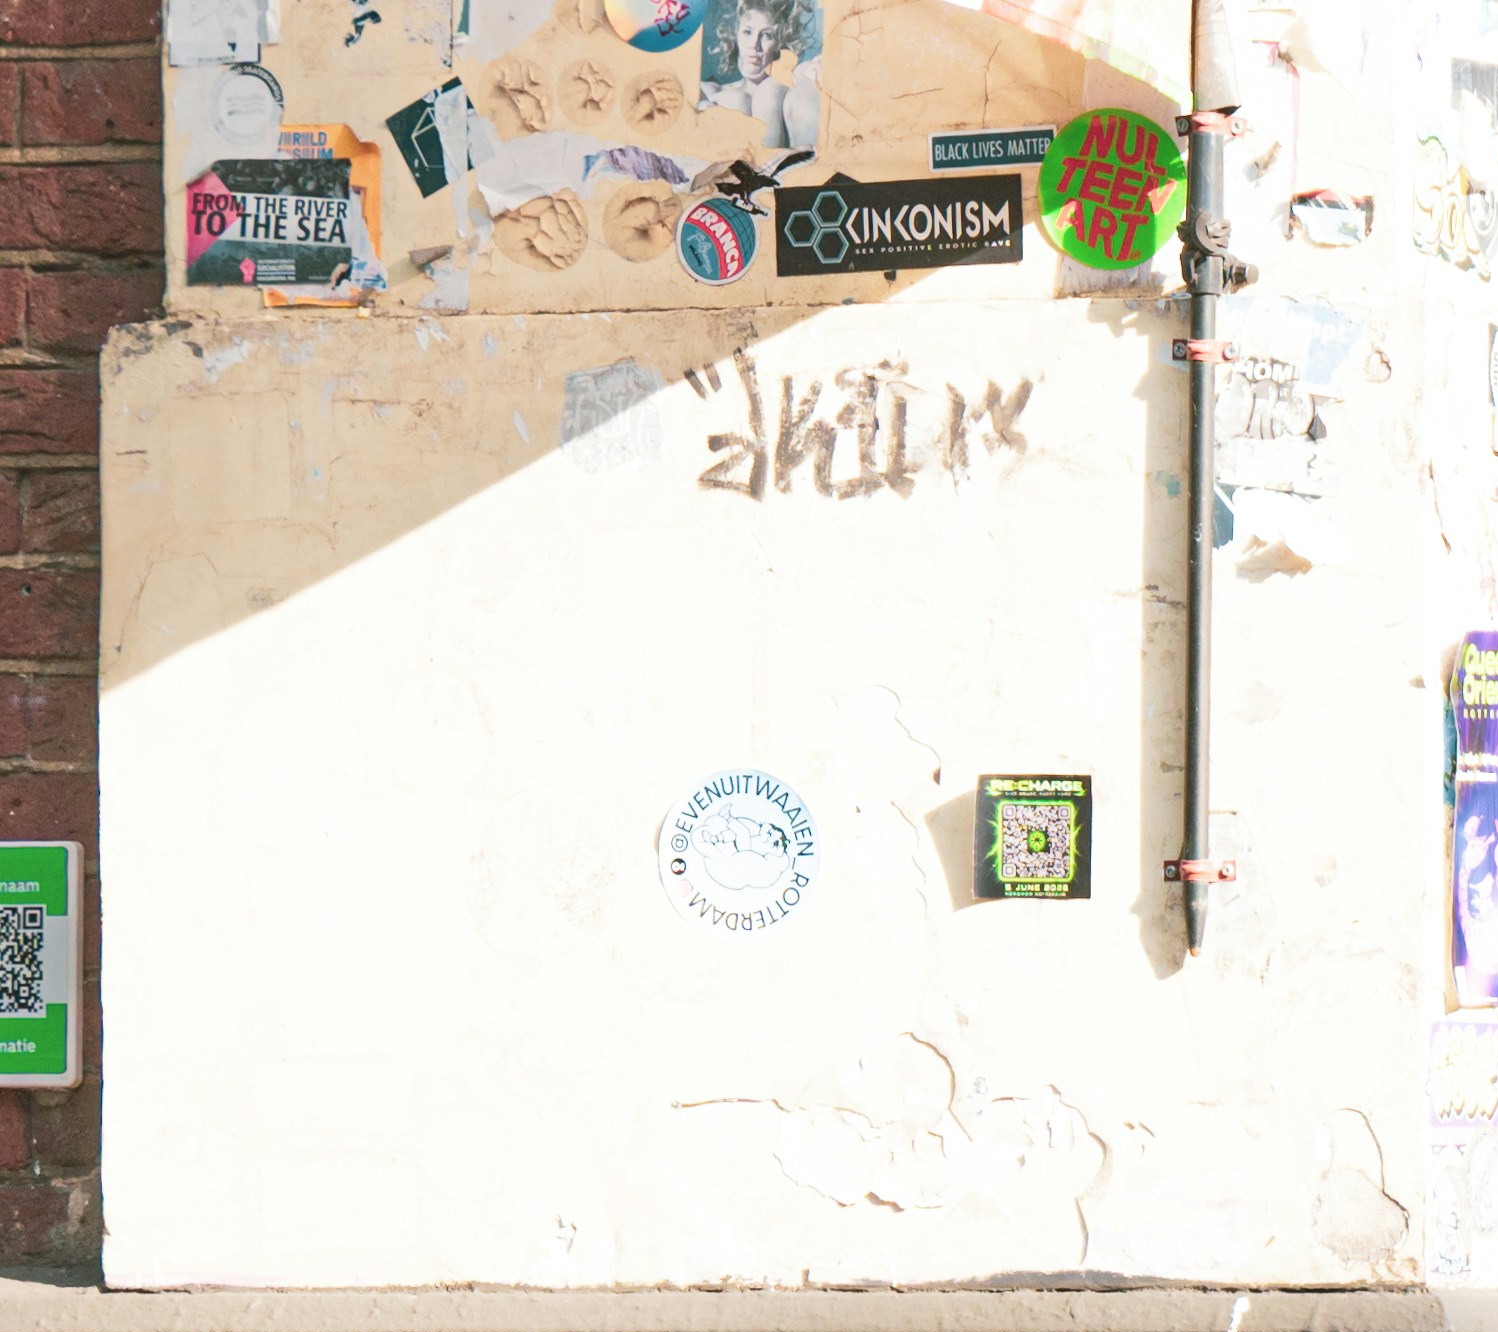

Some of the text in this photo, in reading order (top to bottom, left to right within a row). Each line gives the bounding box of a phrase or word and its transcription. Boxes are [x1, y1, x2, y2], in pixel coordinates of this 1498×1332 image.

[934, 138, 1052, 162] BLACK LIVES MATTER
[1083, 115, 1164, 173] NUL
[1057, 157, 1177, 217] TEEN
[192, 192, 348, 219] FROM THE RIVER
[846, 200, 1011, 244] KINKONISM
[192, 209, 347, 244] TO THE SEA
[690, 205, 742, 280] BRANCA
[855, 239, 1011, 256] SEX POSITIVE EROTIC RAVE
[1015, 883, 1039, 892] JUNE
